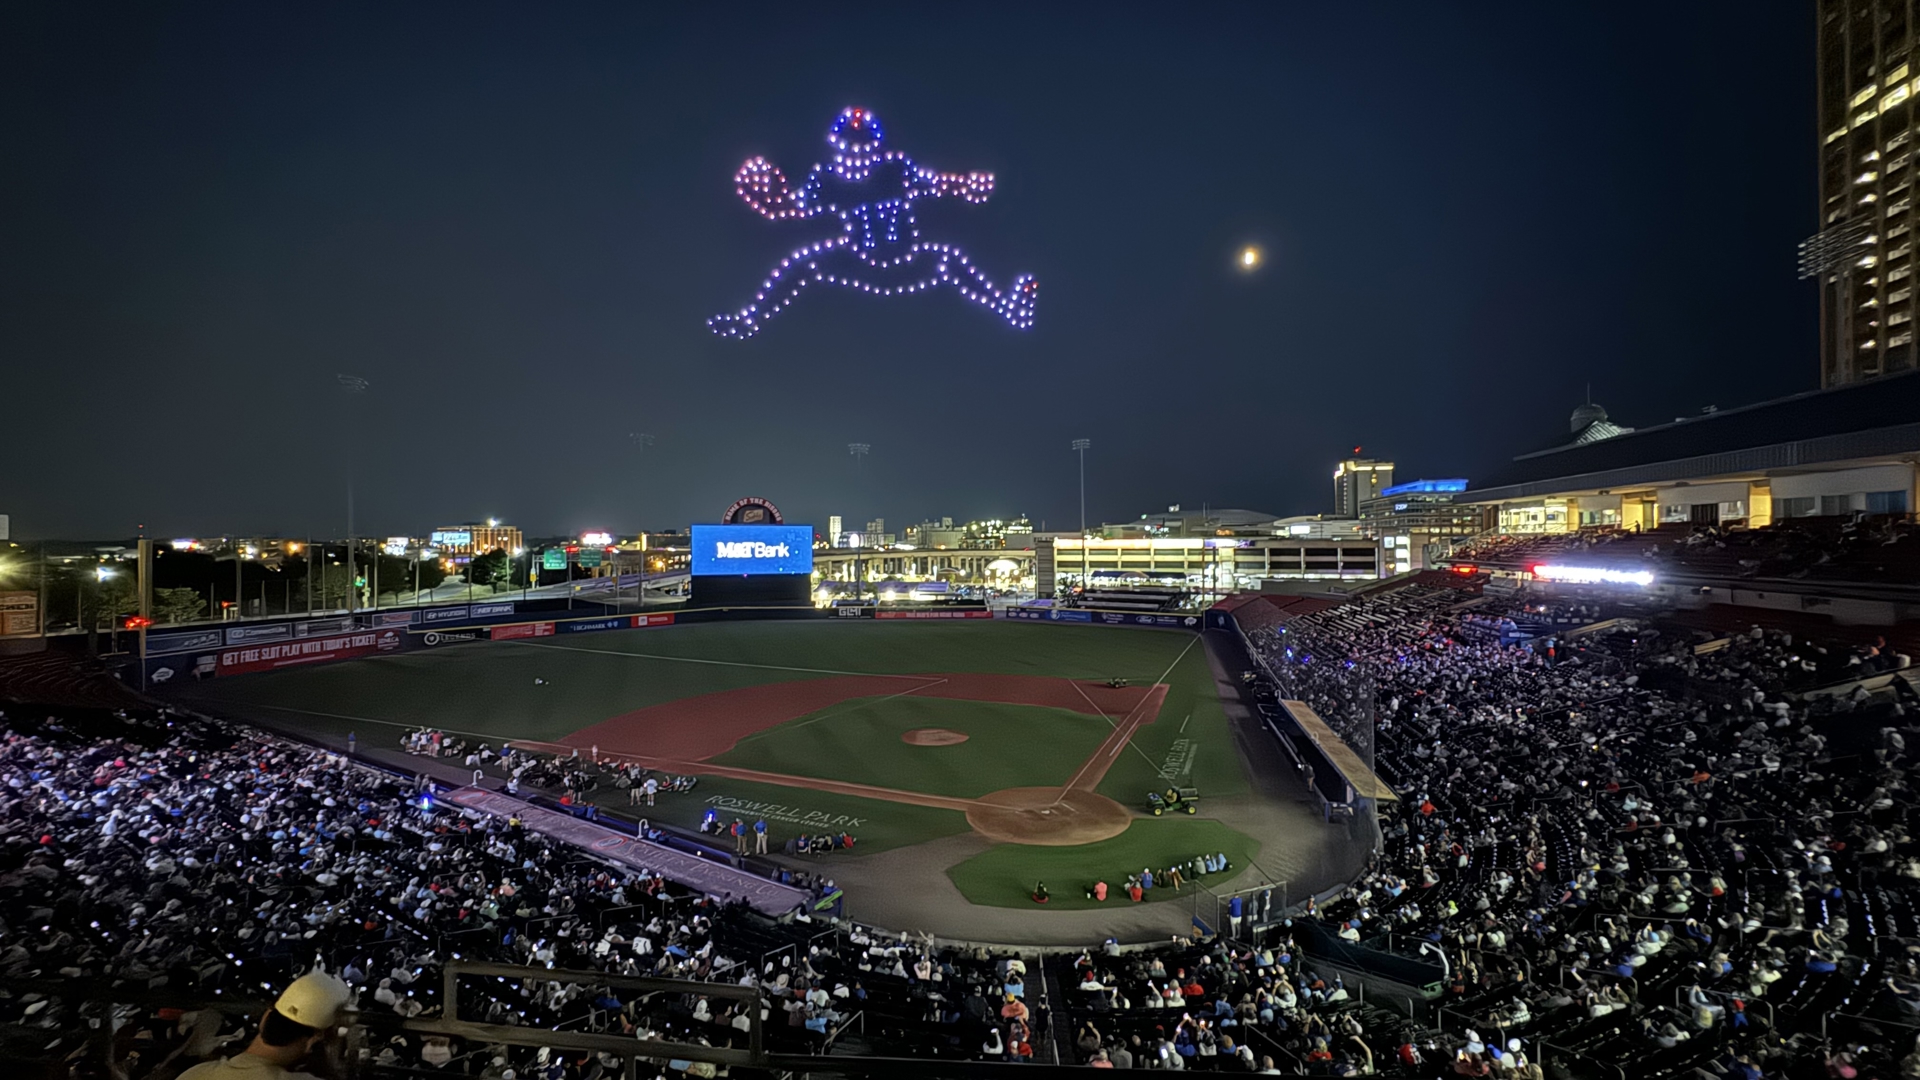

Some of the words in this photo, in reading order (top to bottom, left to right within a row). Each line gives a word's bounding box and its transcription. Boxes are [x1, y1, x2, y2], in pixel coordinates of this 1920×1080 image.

[725, 503, 740, 521] HOME
[739, 498, 748, 506] OF
[764, 501, 782, 521] BISONS
[755, 541, 790, 558] Bank
[438, 609, 467, 618] HYUNDAI
[222, 652, 240, 666] GET
[240, 649, 260, 663] FREE
[261, 646, 281, 660] SLOT
[281, 643, 300, 657] PLAY
[302, 641, 321, 654] WITH
[351, 634, 376, 648] TICKET!
[705, 795, 800, 818] ROSWELL
[804, 810, 868, 828] PARK
